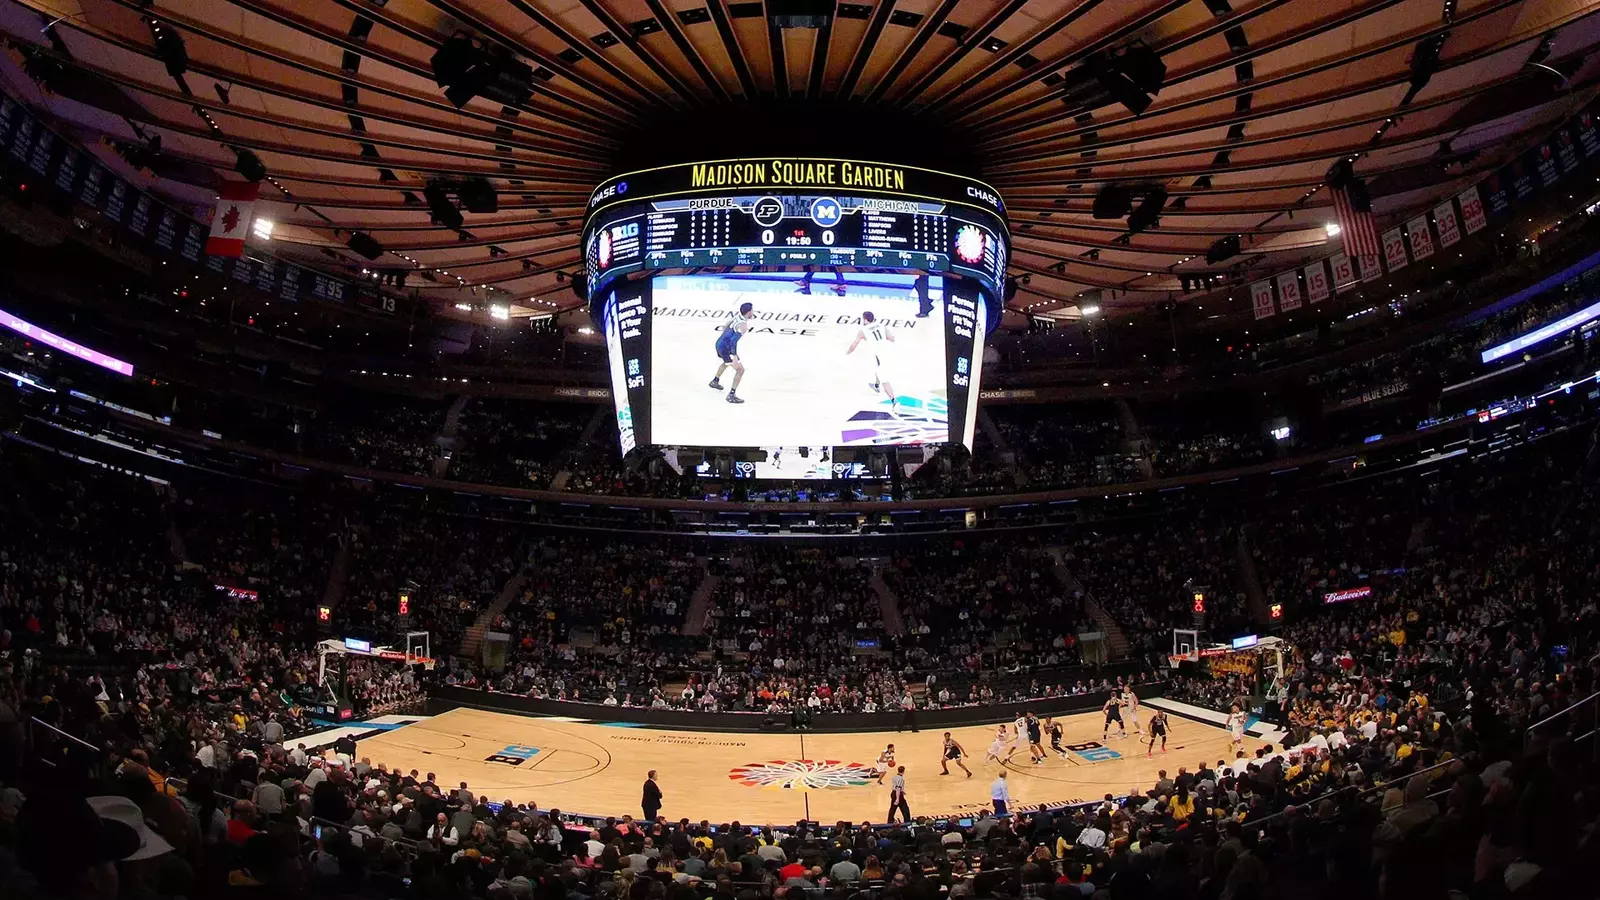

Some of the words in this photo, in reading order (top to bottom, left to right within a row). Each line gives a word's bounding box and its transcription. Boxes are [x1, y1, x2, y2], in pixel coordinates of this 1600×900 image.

[691, 163, 765, 187] MADISON
[772, 160, 836, 185] SQUARE
[842, 162, 904, 190] GARDEN
[591, 186, 616, 207] CHASE
[690, 198, 732, 208] PURDUE
[966, 187, 998, 206] CHASE
[862, 199, 919, 212] MICHIGAN
[762, 230, 774, 245] 0
[822, 230, 835, 245] 0
[786, 237, 811, 245] 19:50
[1412, 228, 1429, 248] 24
[1386, 240, 1402, 260] 22
[1336, 263, 1350, 280] 15
[1310, 273, 1324, 290] 15
[1282, 283, 1296, 300] 12
[382, 296, 396, 312] 13
[1256, 292, 1269, 308] 10
[652, 307, 739, 319] MADISON
[752, 310, 829, 324] SQUARE
[836, 315, 916, 328] GADEN
[872, 329, 883, 341] 11
[628, 375, 644, 388] SoFi
[953, 374, 968, 387] SoFi
[1363, 390, 1381, 402] BLUE
[1325, 589, 1370, 603] Budweiser
